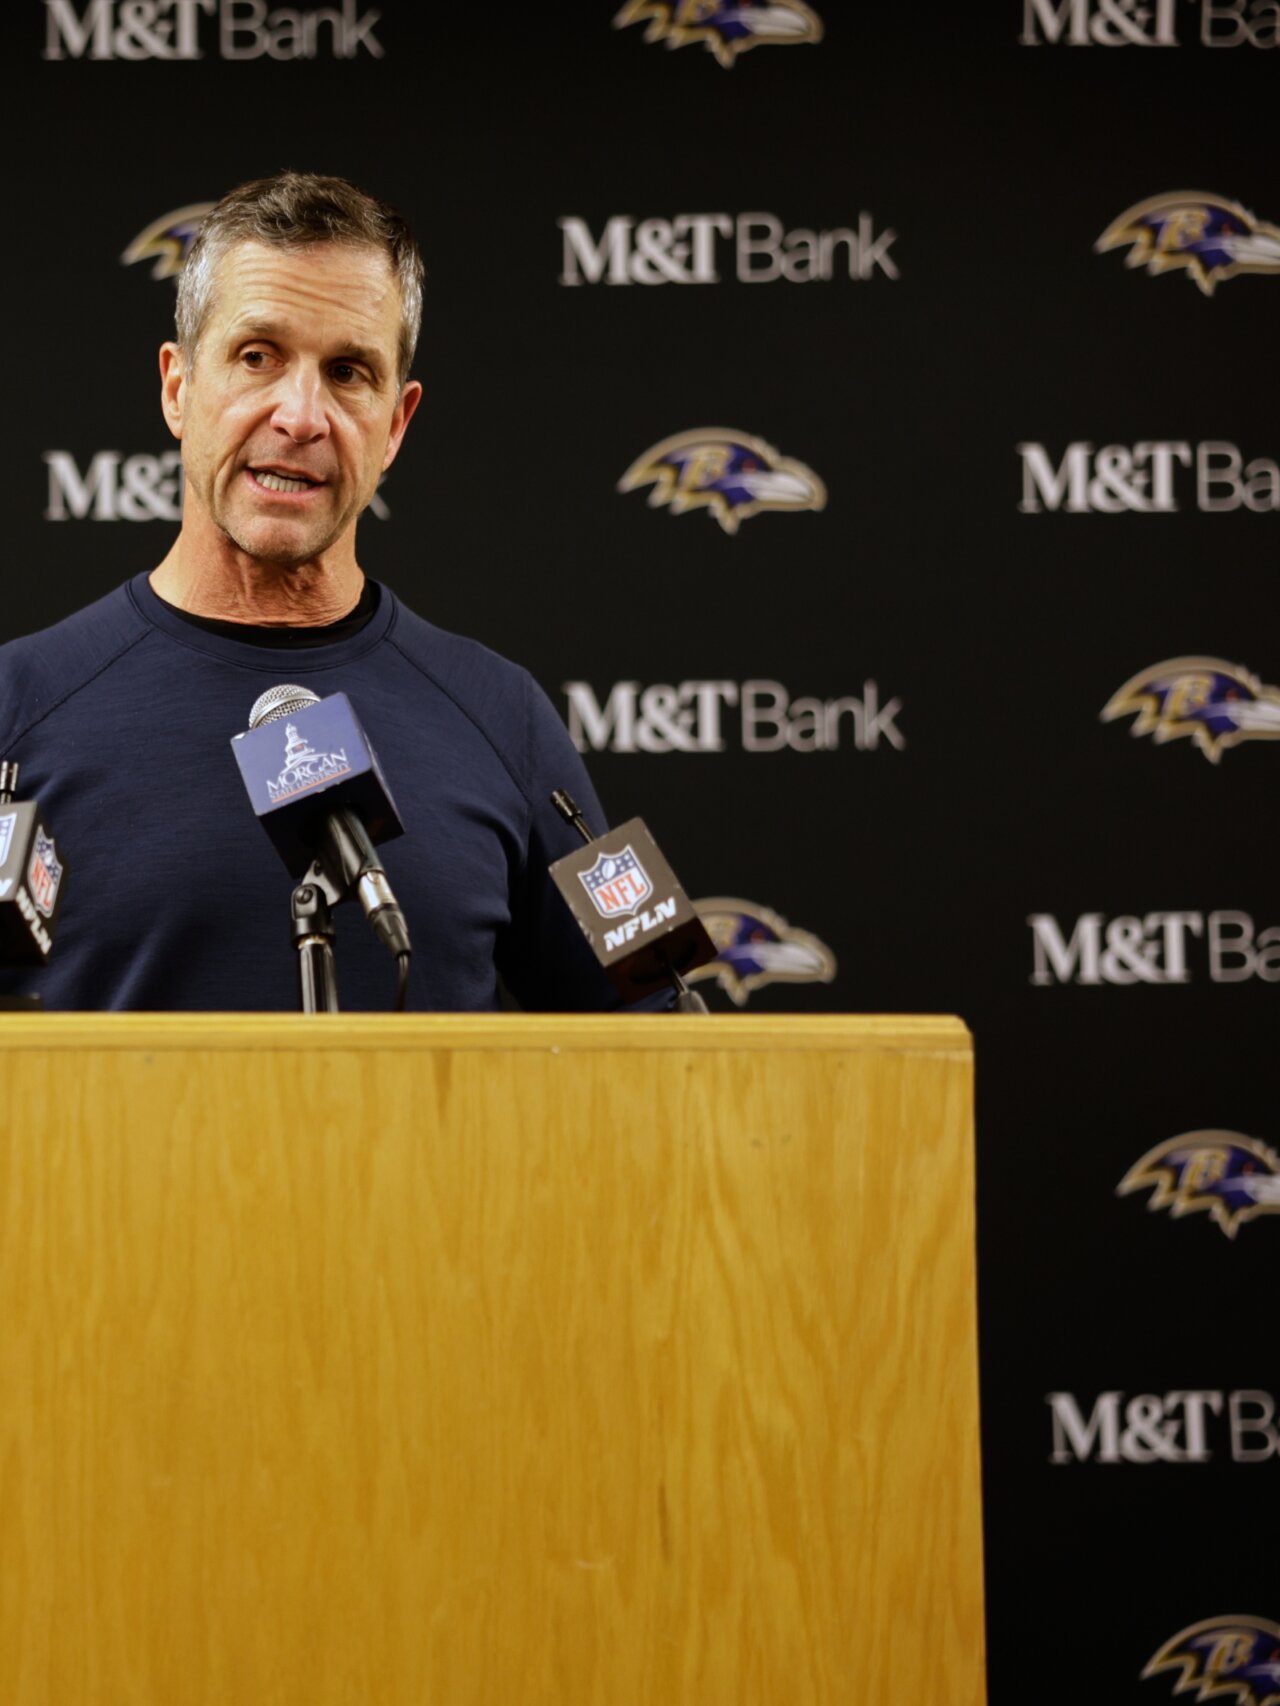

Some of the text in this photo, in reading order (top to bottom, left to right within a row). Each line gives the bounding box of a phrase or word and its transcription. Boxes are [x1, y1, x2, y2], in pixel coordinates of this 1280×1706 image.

[47, 0, 377, 59] M&T Bank
[562, 214, 896, 285] M&T Bank
[1021, 442, 1192, 513] M&T
[563, 681, 902, 752] M&T Bank
[266, 749, 347, 792] MORGAN
[32, 857, 52, 908] NFL
[598, 871, 645, 910] NFL
[604, 898, 677, 951] NFLN
[1032, 912, 1202, 985] M&T
[1051, 1392, 1222, 1462] M&T
